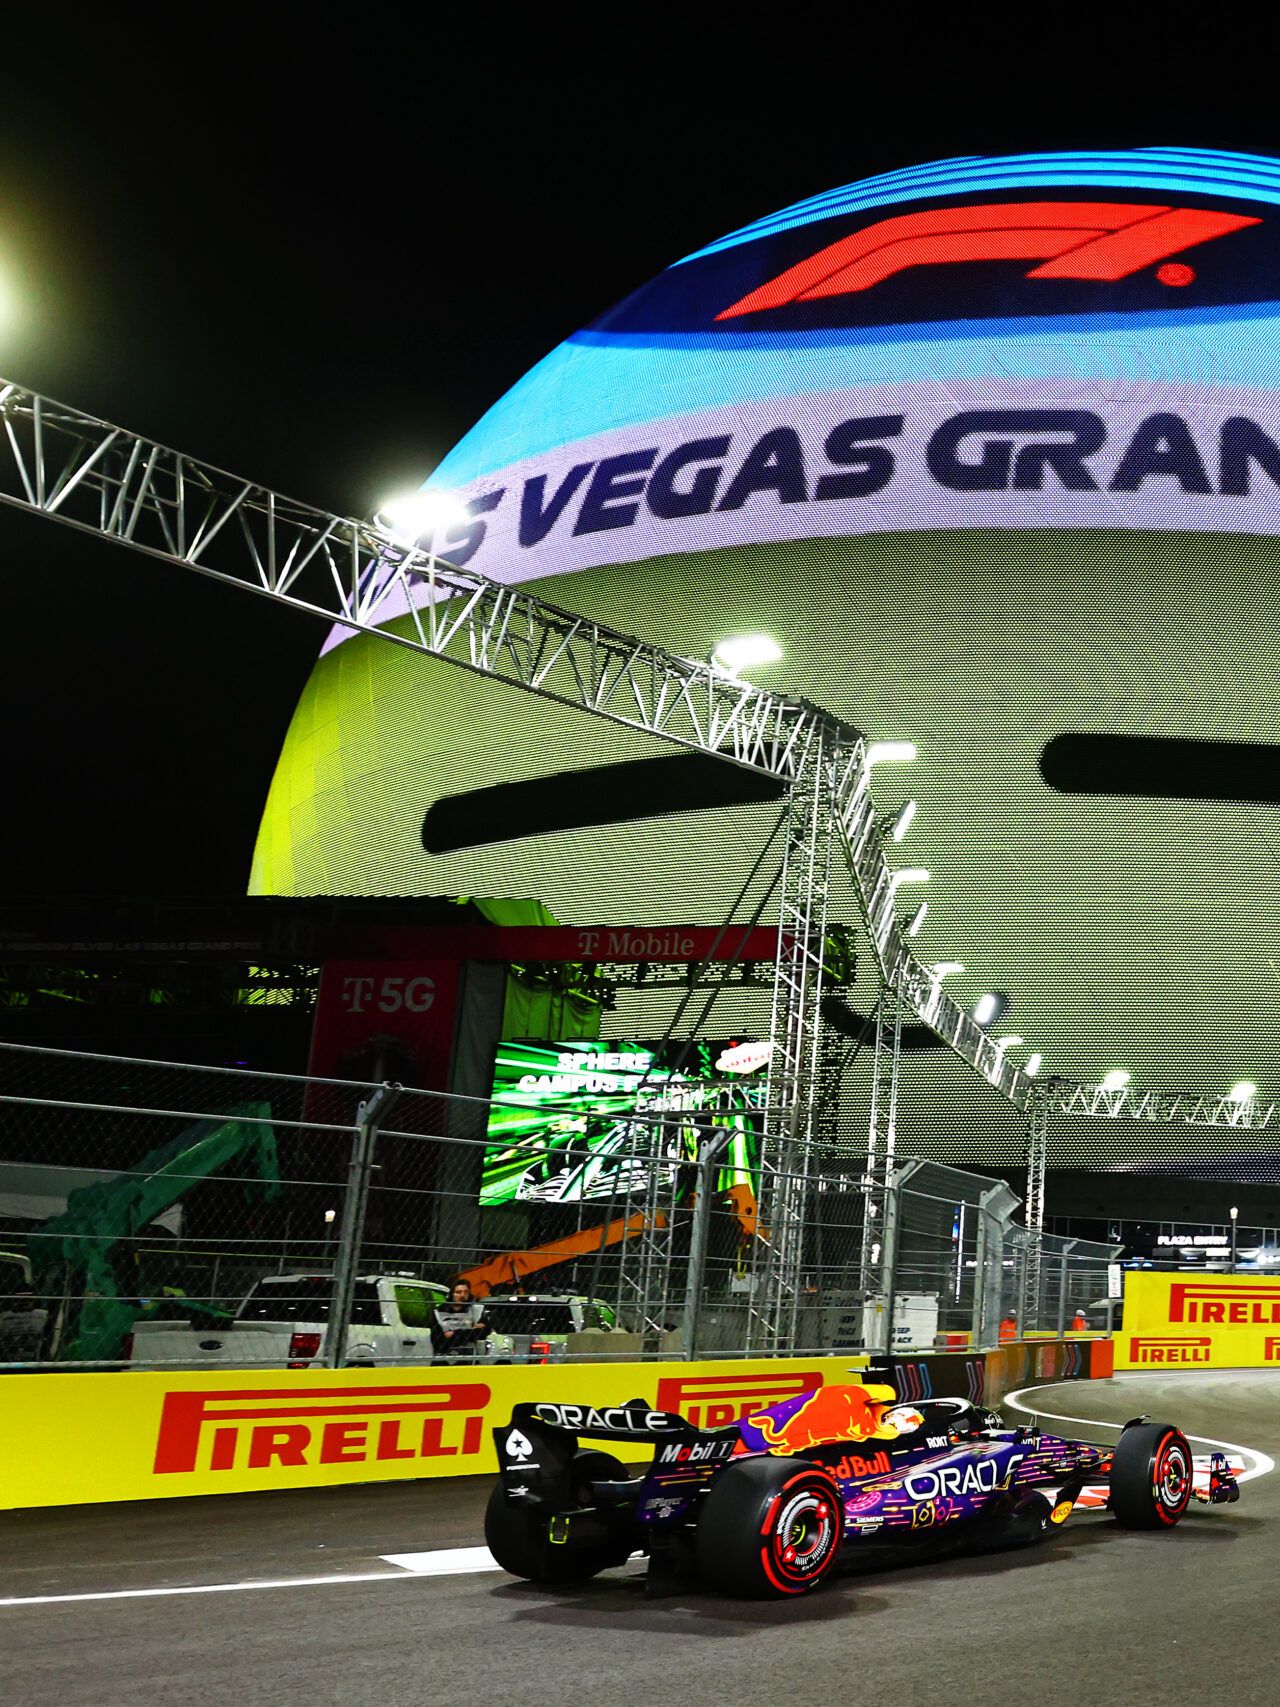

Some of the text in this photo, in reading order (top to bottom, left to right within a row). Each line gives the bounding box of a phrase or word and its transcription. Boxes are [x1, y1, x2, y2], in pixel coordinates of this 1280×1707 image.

[712, 202, 1263, 321] F1
[519, 414, 904, 547] VEGAS
[606, 932, 695, 956] Mobile
[378, 977, 436, 1012] 5G
[558, 1052, 652, 1070] SPHERE
[519, 1074, 619, 1093] CAMPUS
[1157, 1236, 1193, 1245] PLAZA
[1130, 1337, 1212, 1363] PIRELLI
[656, 1372, 824, 1430] PIRE
[153, 1383, 492, 1474] PIRELLI
[535, 1404, 669, 1432] ORACLE
[659, 1442, 717, 1463] Mobil
[926, 1436, 948, 1449] ROKT
[850, 1451, 891, 1477] Bull
[904, 1454, 1024, 1501] ORACLE
